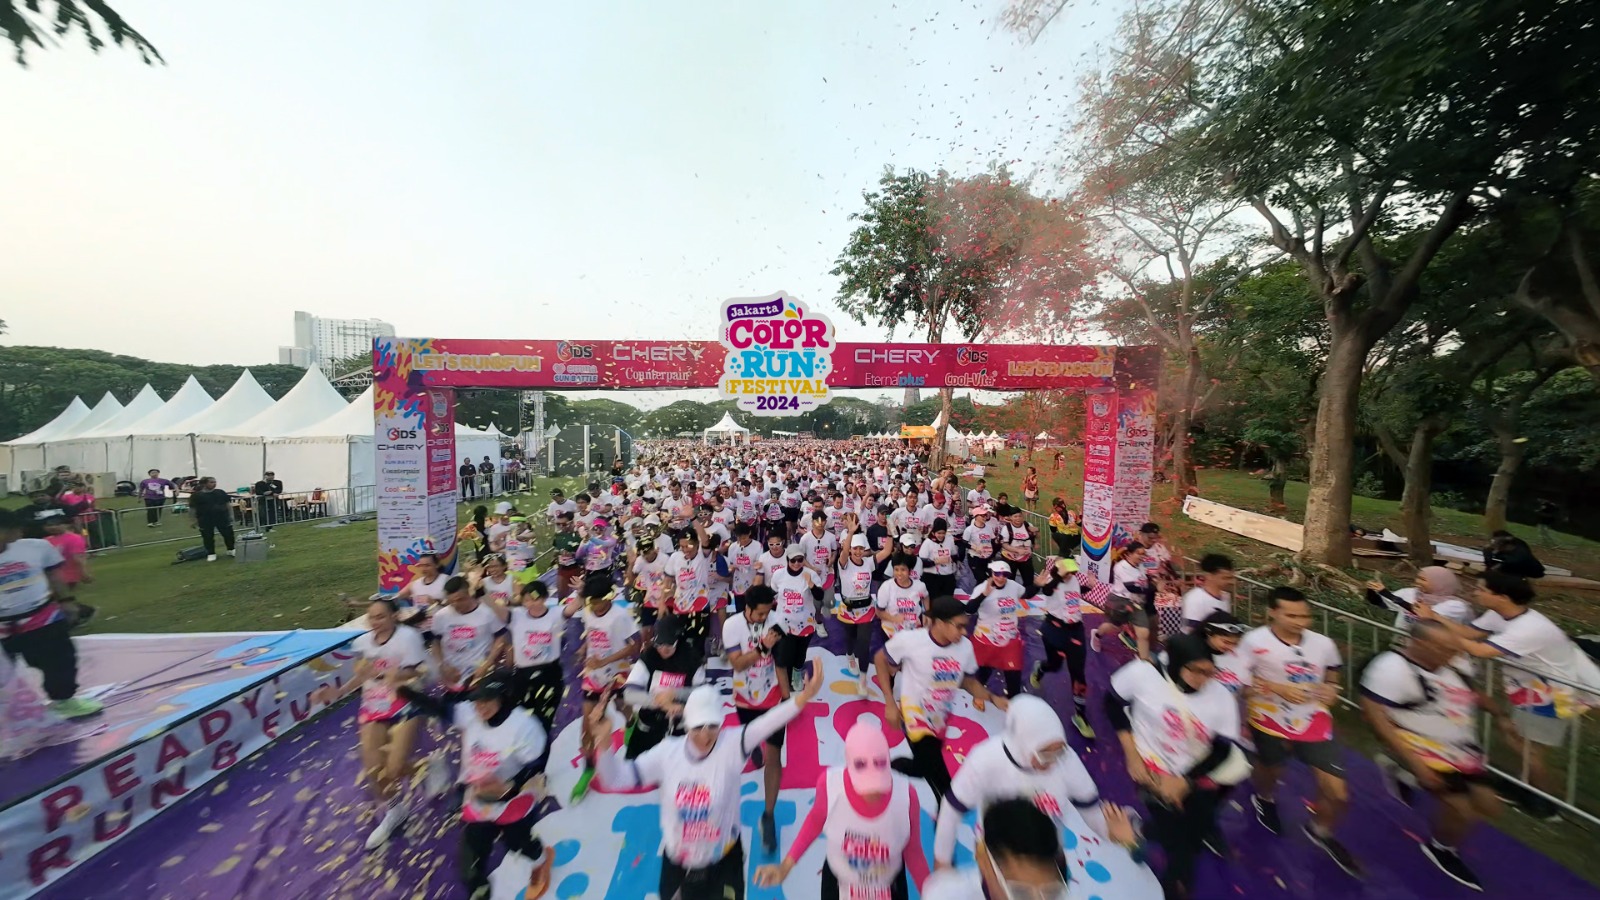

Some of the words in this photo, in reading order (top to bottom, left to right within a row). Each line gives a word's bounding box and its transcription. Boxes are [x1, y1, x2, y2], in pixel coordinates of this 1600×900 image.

[731, 304, 780, 318] Jakarta
[729, 319, 830, 349] COLOR
[612, 345, 706, 361] CHERY
[854, 348, 941, 364] CHERY
[740, 350, 816, 378] RUN
[625, 368, 690, 381] Counterpain
[865, 372, 925, 387] Eternalplus
[945, 372, 995, 387] Cool-Vita
[729, 379, 828, 395] FESTIVAL
[756, 396, 800, 410] 2024
